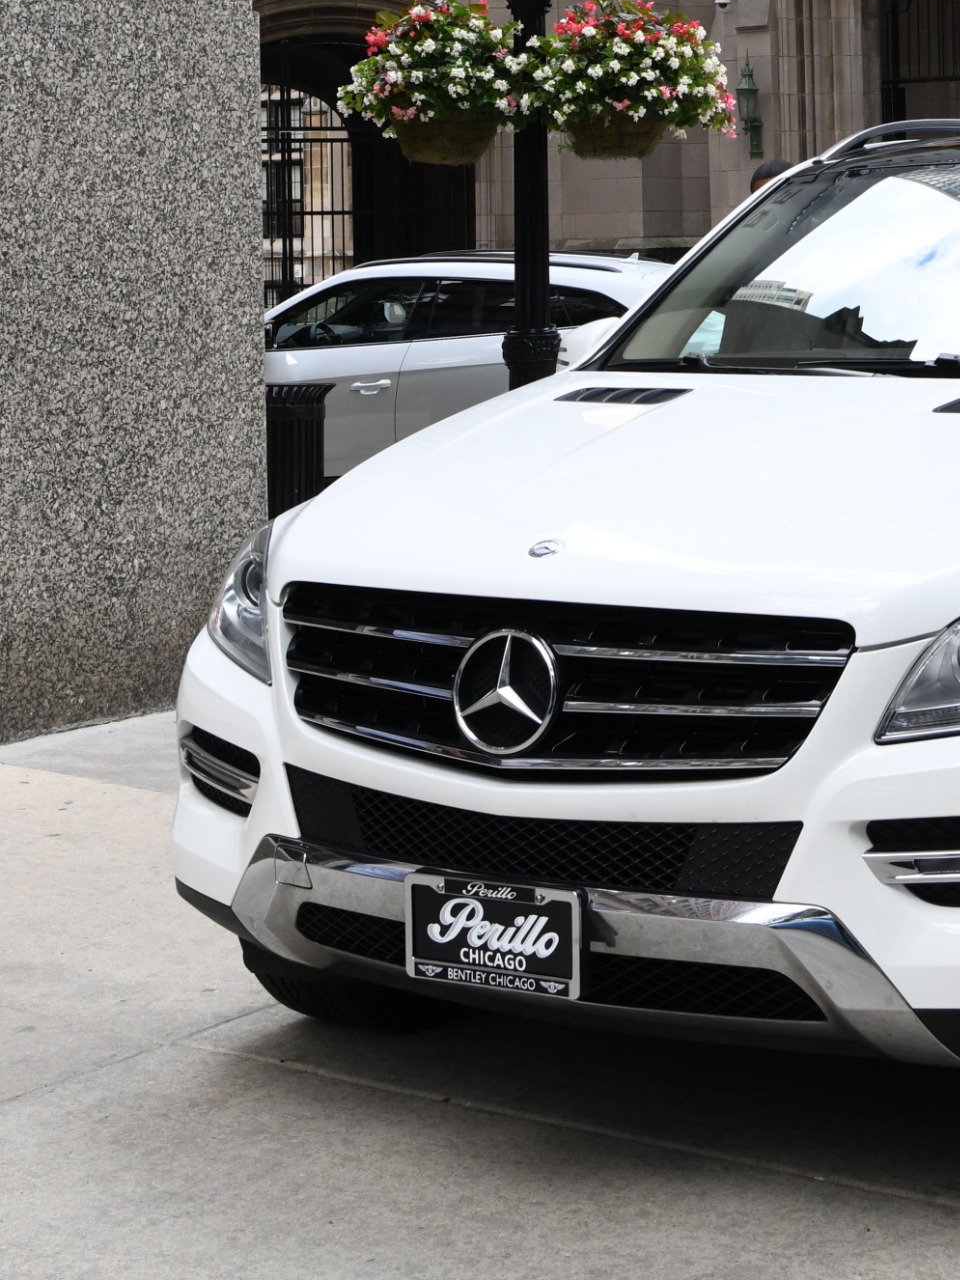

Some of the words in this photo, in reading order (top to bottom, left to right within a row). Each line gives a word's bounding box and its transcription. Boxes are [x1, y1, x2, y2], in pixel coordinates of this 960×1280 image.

[462, 881, 517, 900] Perillo
[427, 897, 560, 959] Perillo
[460, 948, 527, 971] CHICAGO
[447, 967, 487, 984] BENTLEY
[489, 973, 536, 991] CHICAGO
